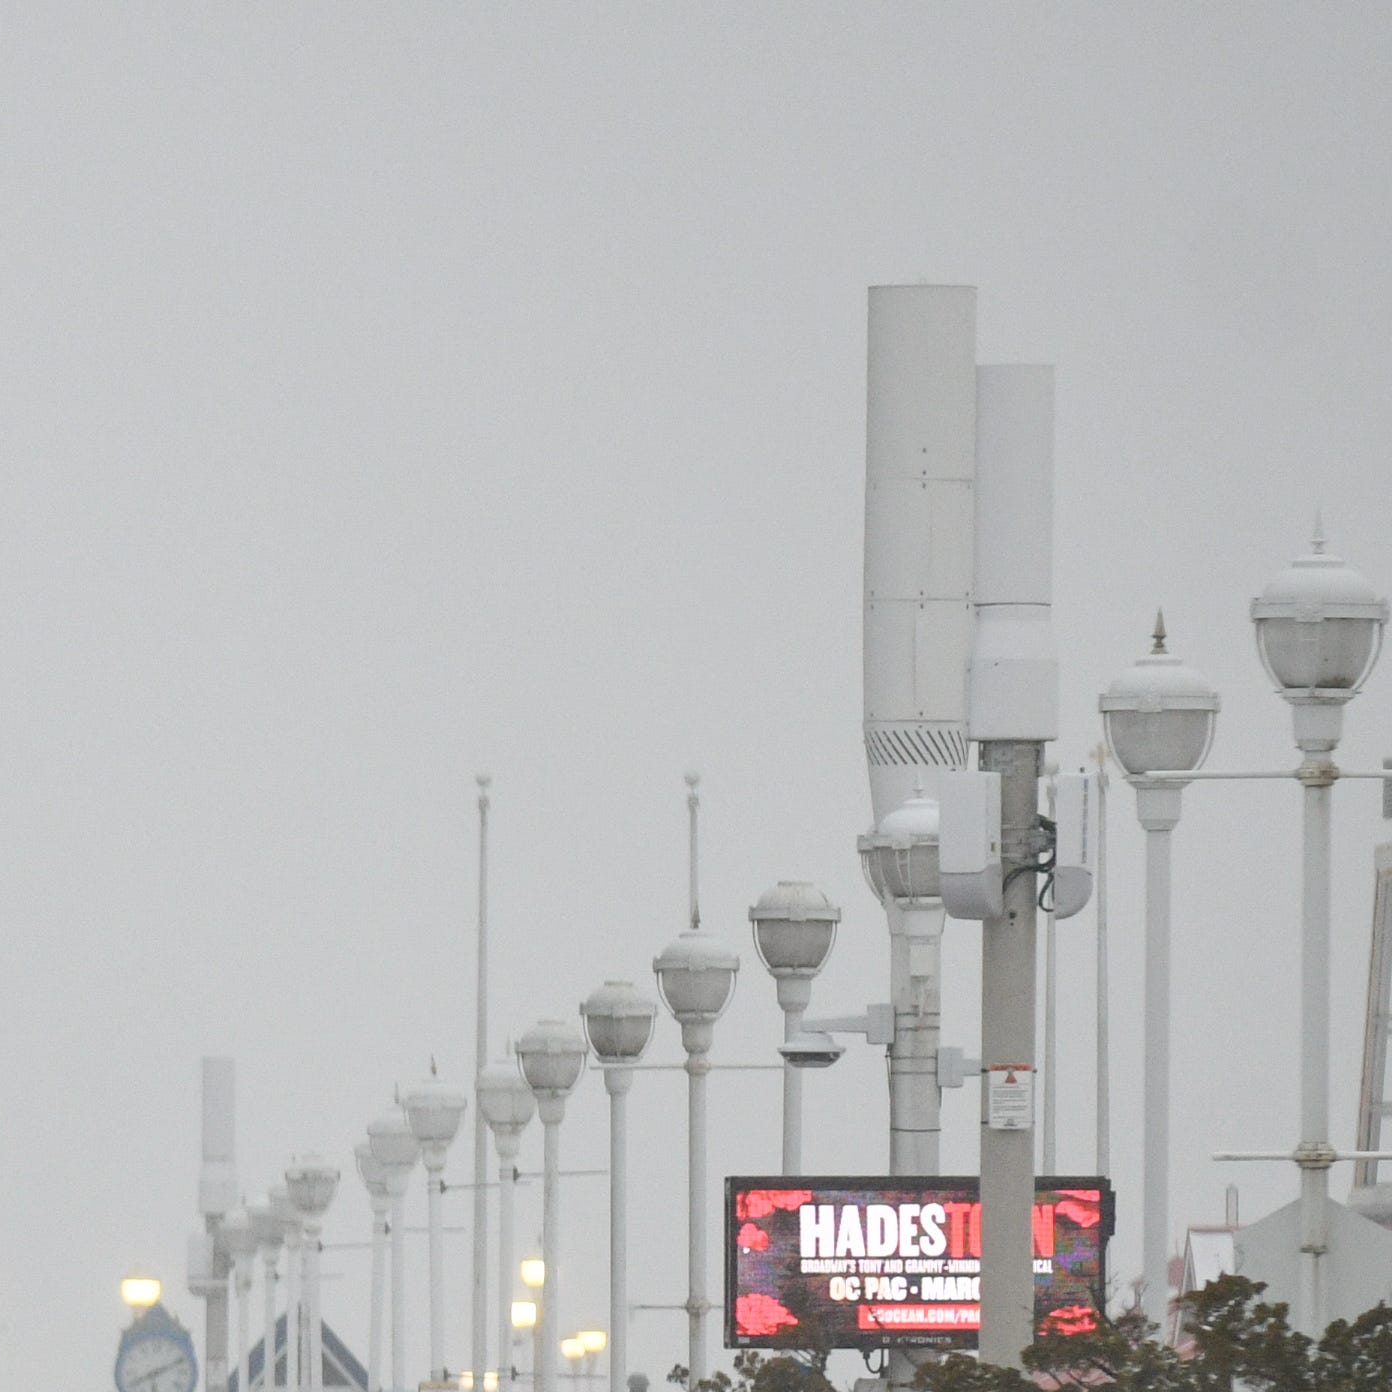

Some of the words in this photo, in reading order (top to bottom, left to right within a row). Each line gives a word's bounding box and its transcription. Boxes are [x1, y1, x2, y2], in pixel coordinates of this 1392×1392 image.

[800, 1203, 1055, 1258] HADESTN
[829, 1276, 861, 1301] OC
[865, 1276, 908, 1301] PAC
